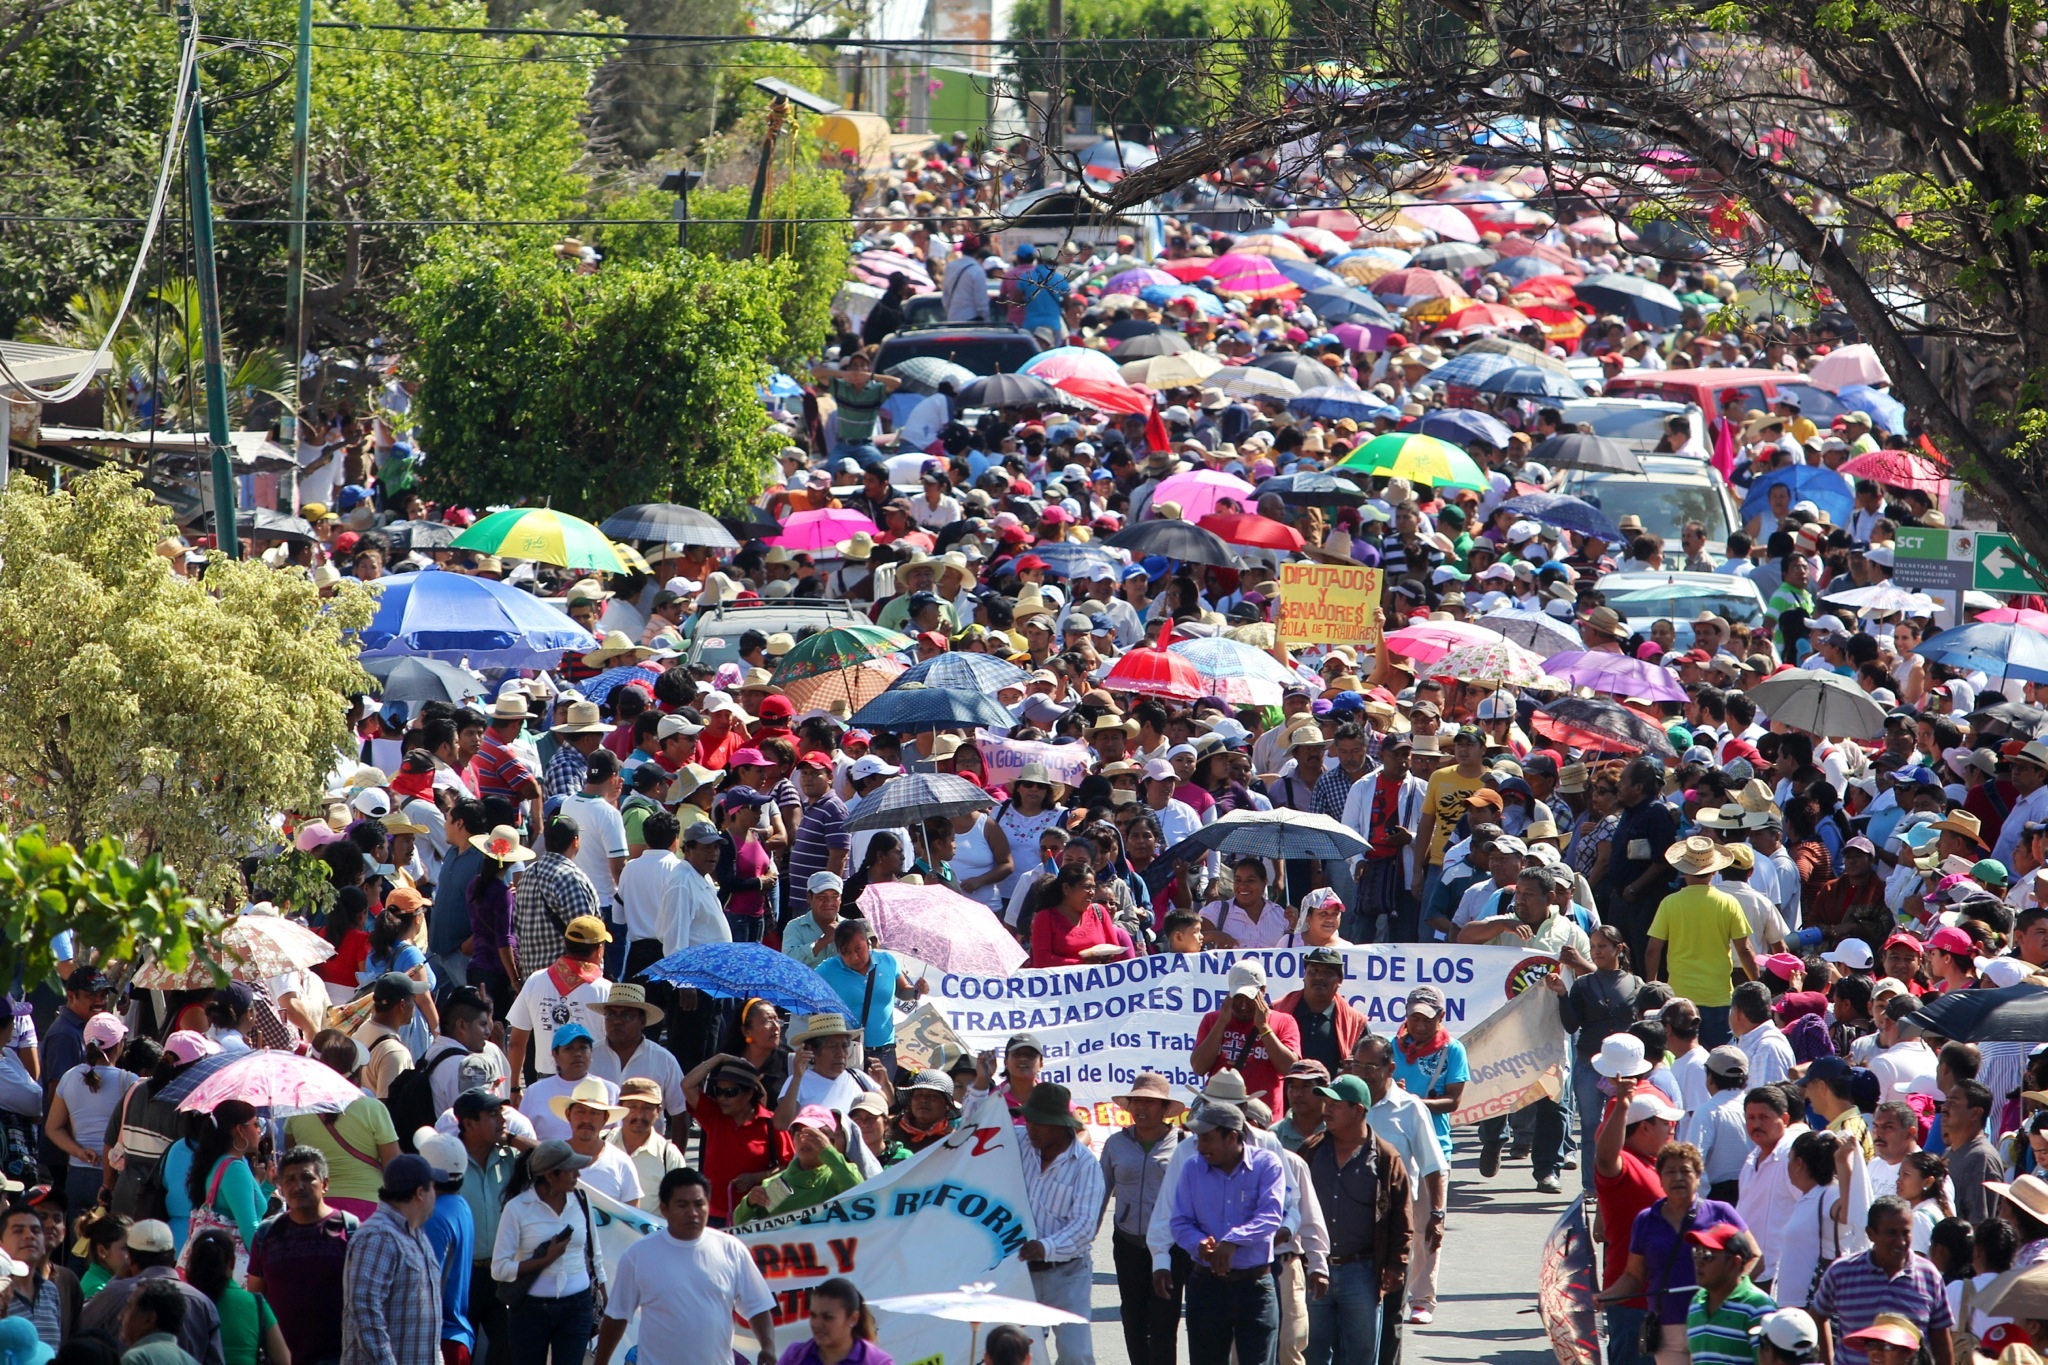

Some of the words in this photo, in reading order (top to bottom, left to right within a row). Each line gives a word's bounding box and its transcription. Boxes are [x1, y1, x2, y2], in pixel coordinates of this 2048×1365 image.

[1896, 536, 1925, 549] SCT
[1895, 562, 1937, 570] SECRETARÍA
[1895, 569, 1957, 578] COMUNICACIONES
[1902, 577, 1949, 585] TRANSPORTES
[1318, 587, 1328, 606] Y
[1280, 621, 1308, 637] BOLA
[1312, 624, 1323, 633] DE
[996, 749, 1064, 770] GOBIERNO
[941, 952, 1190, 1000] COORDINADORA
[1200, 951, 1357, 980] NAIOL
[1367, 955, 1406, 982] DE
[1416, 957, 1475, 984] LOS
[947, 985, 1184, 1031] TRABAJADORES
[1077, 1038, 1104, 1055] de
[1110, 1032, 1142, 1048] los
[1147, 1030, 1197, 1051] Trab
[1077, 1063, 1102, 1082] de
[1108, 1062, 1136, 1084] los
[894, 1184, 1028, 1271] REFORM
[827, 1236, 858, 1274] Y
